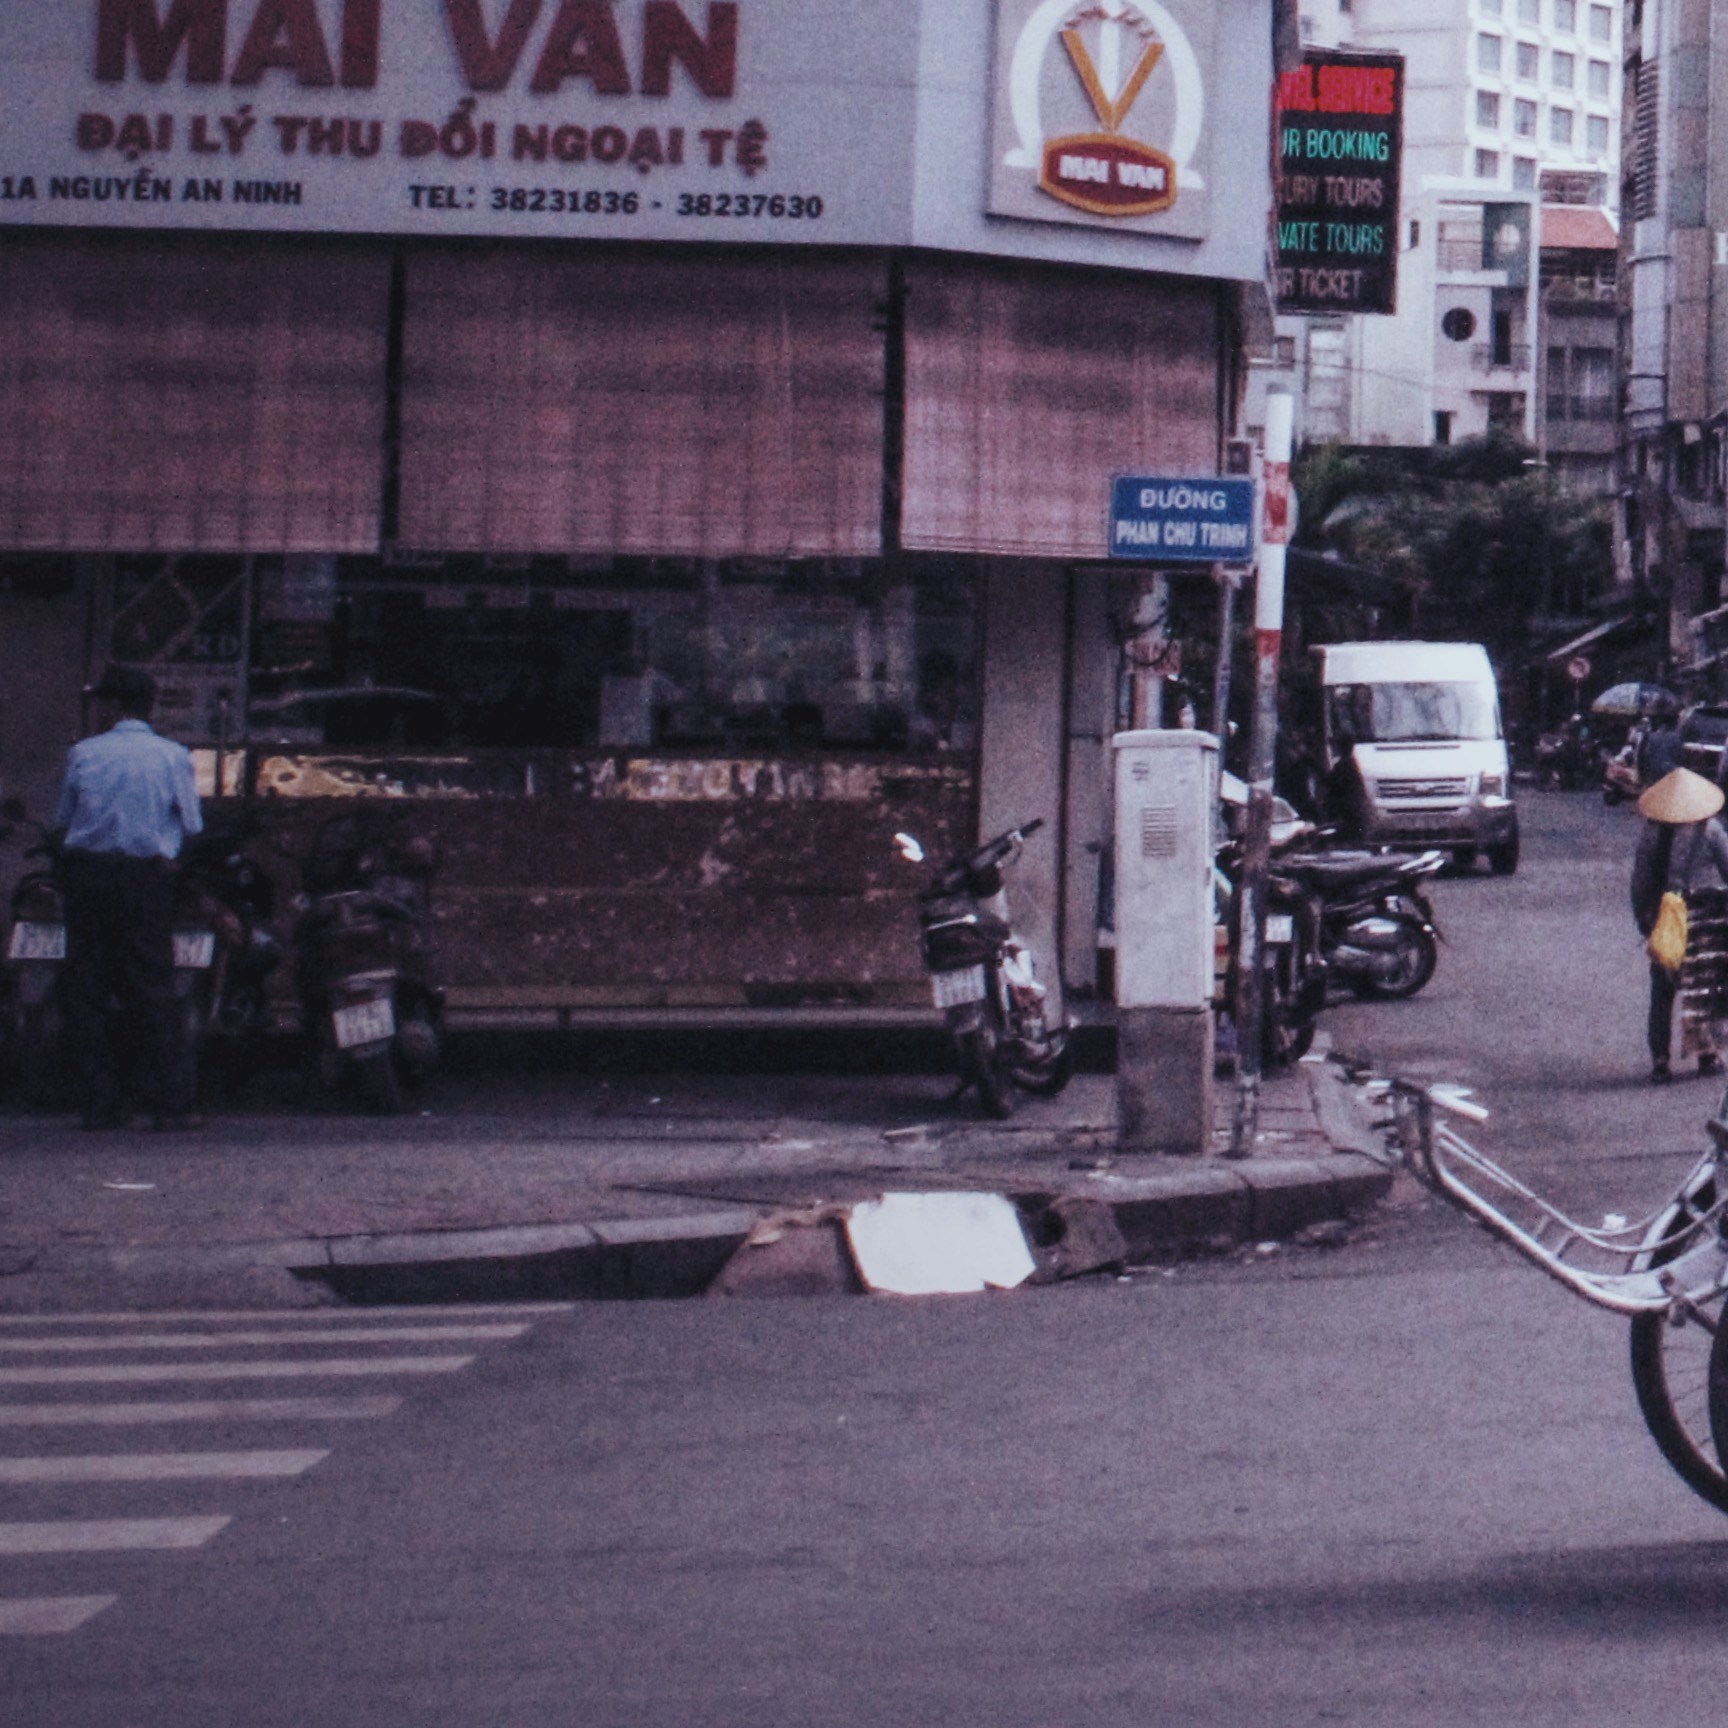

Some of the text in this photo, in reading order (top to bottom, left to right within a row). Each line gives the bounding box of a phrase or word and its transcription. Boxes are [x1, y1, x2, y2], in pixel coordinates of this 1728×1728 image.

[77, 97, 768, 176] ĐẠI LÝ THU ĐỔI NGOẠI TỆ
[1306, 128, 1389, 162] BOOKING
[50, 168, 172, 203] NGUYỄN
[181, 178, 224, 203] AN
[234, 179, 302, 206] NINH
[408, 183, 476, 211] TEL:
[490, 185, 639, 216] 38231836
[676, 190, 823, 219] 38237630
[1326, 223, 1383, 254] TOURS
[1140, 486, 1227, 511] ĐƯỜNG
